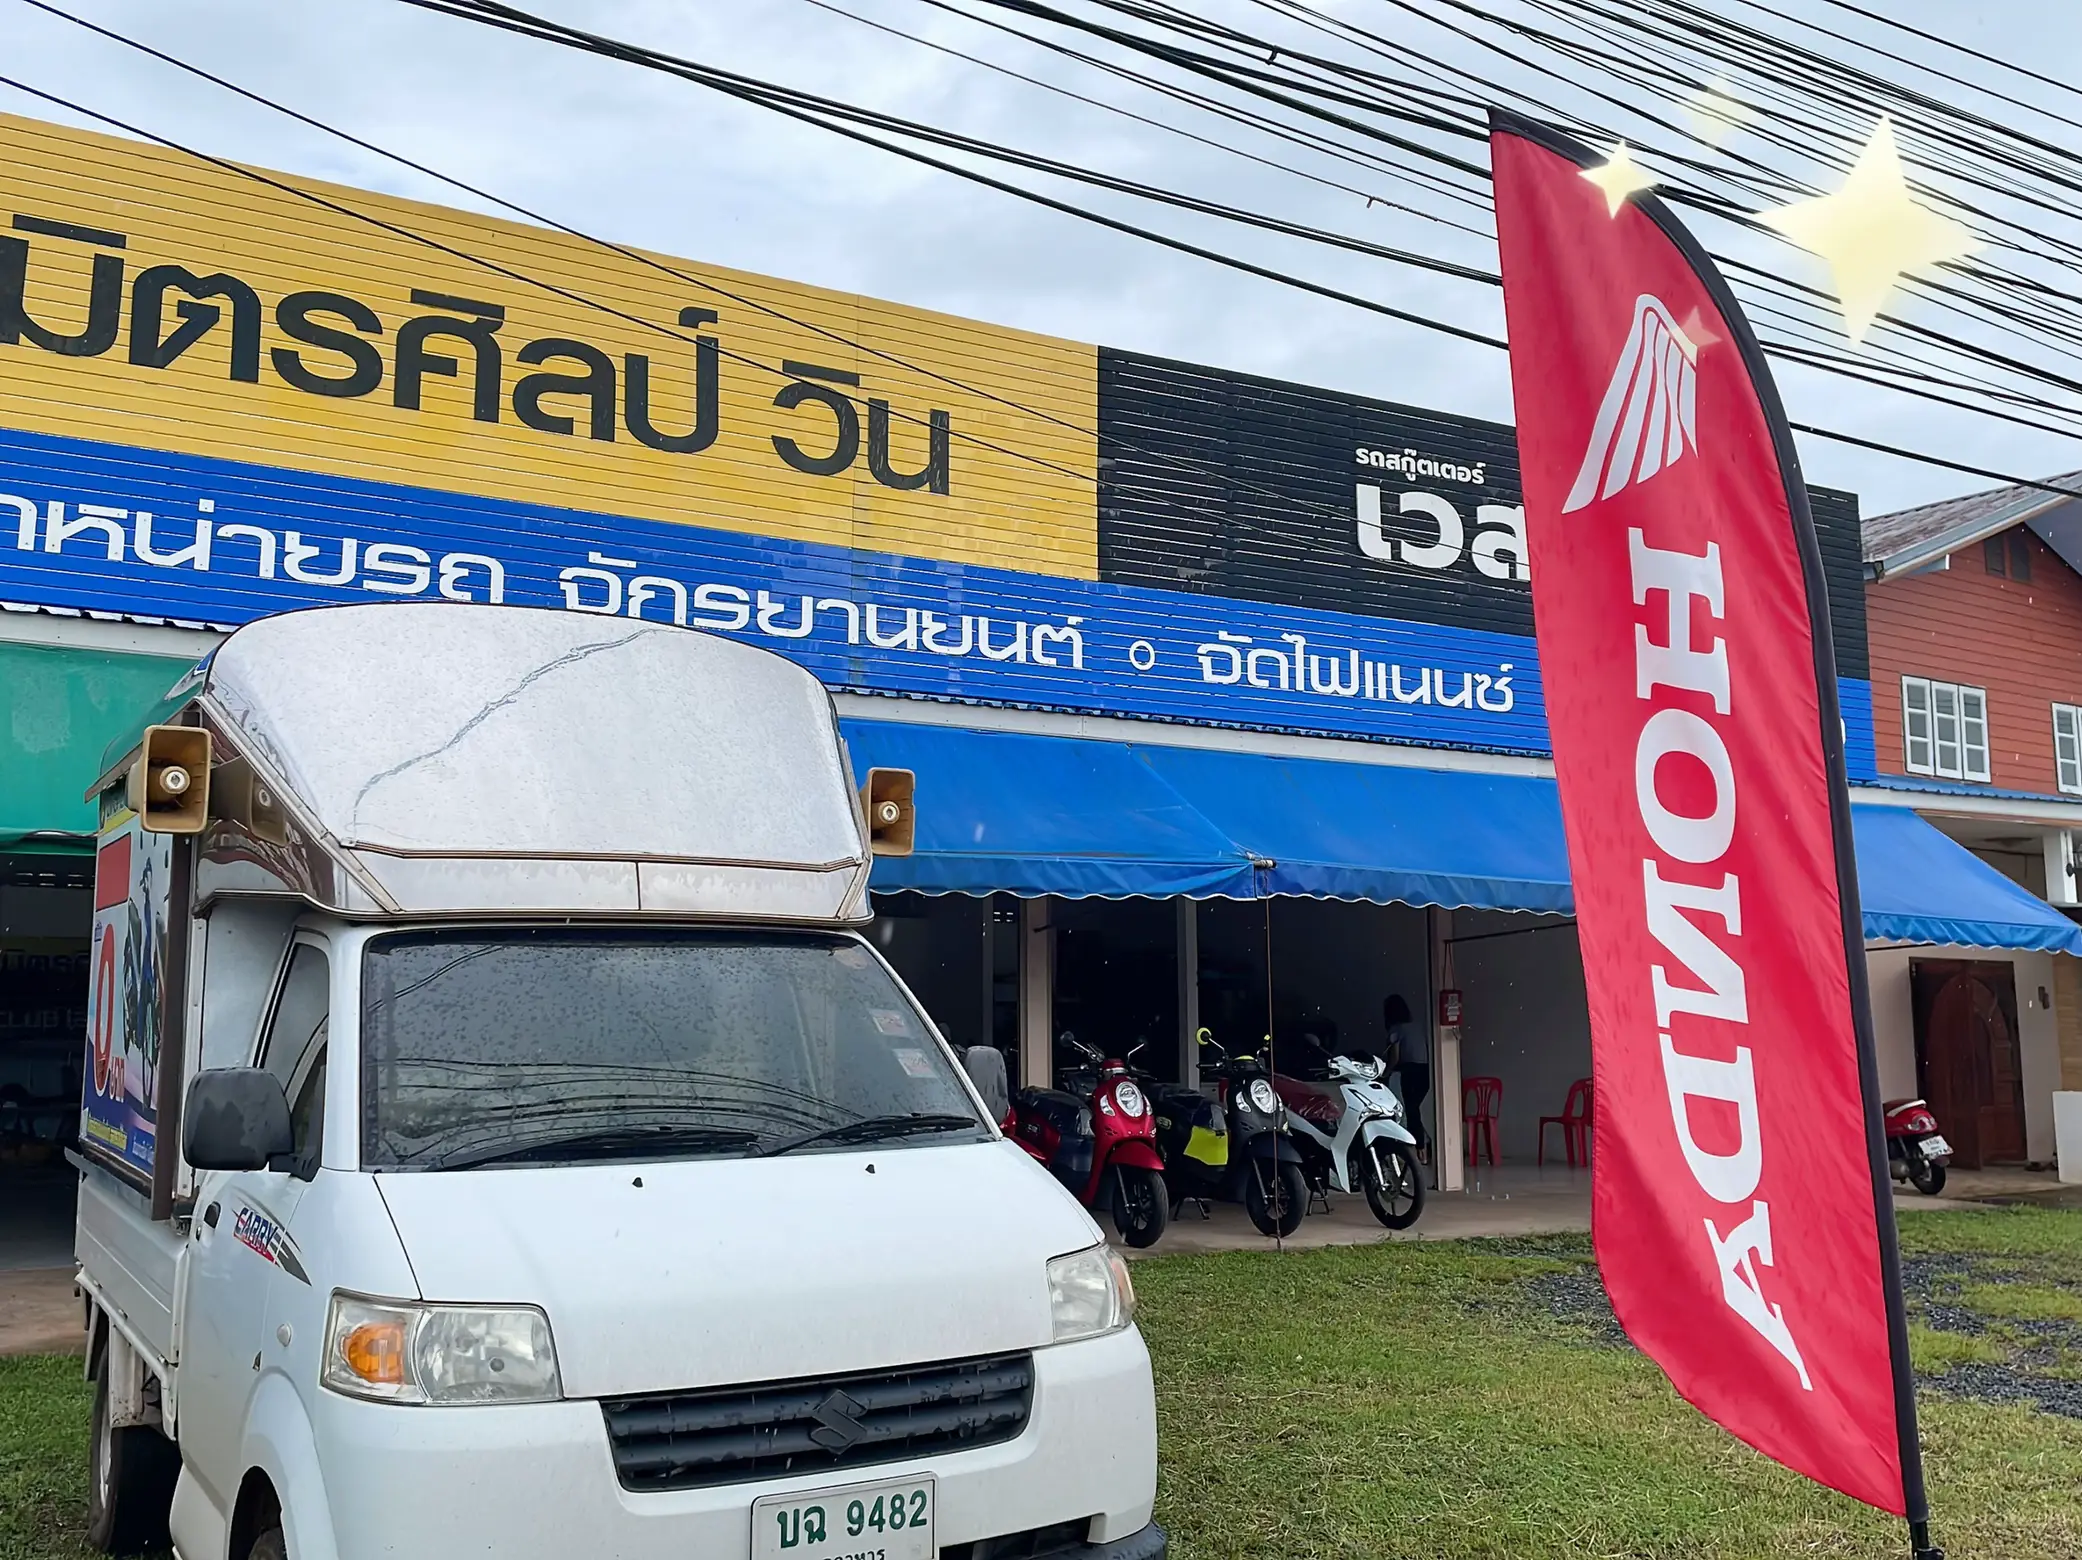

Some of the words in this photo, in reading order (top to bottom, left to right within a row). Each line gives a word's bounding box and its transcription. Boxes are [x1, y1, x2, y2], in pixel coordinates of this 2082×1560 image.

[1356, 448, 1486, 485] รถสกู๊ตเตอร์
[558, 551, 1084, 670] จักรยานยนต์
[1197, 631, 1514, 713] จัดไฟแนนซ์
[846, 1489, 928, 1537] 9482
